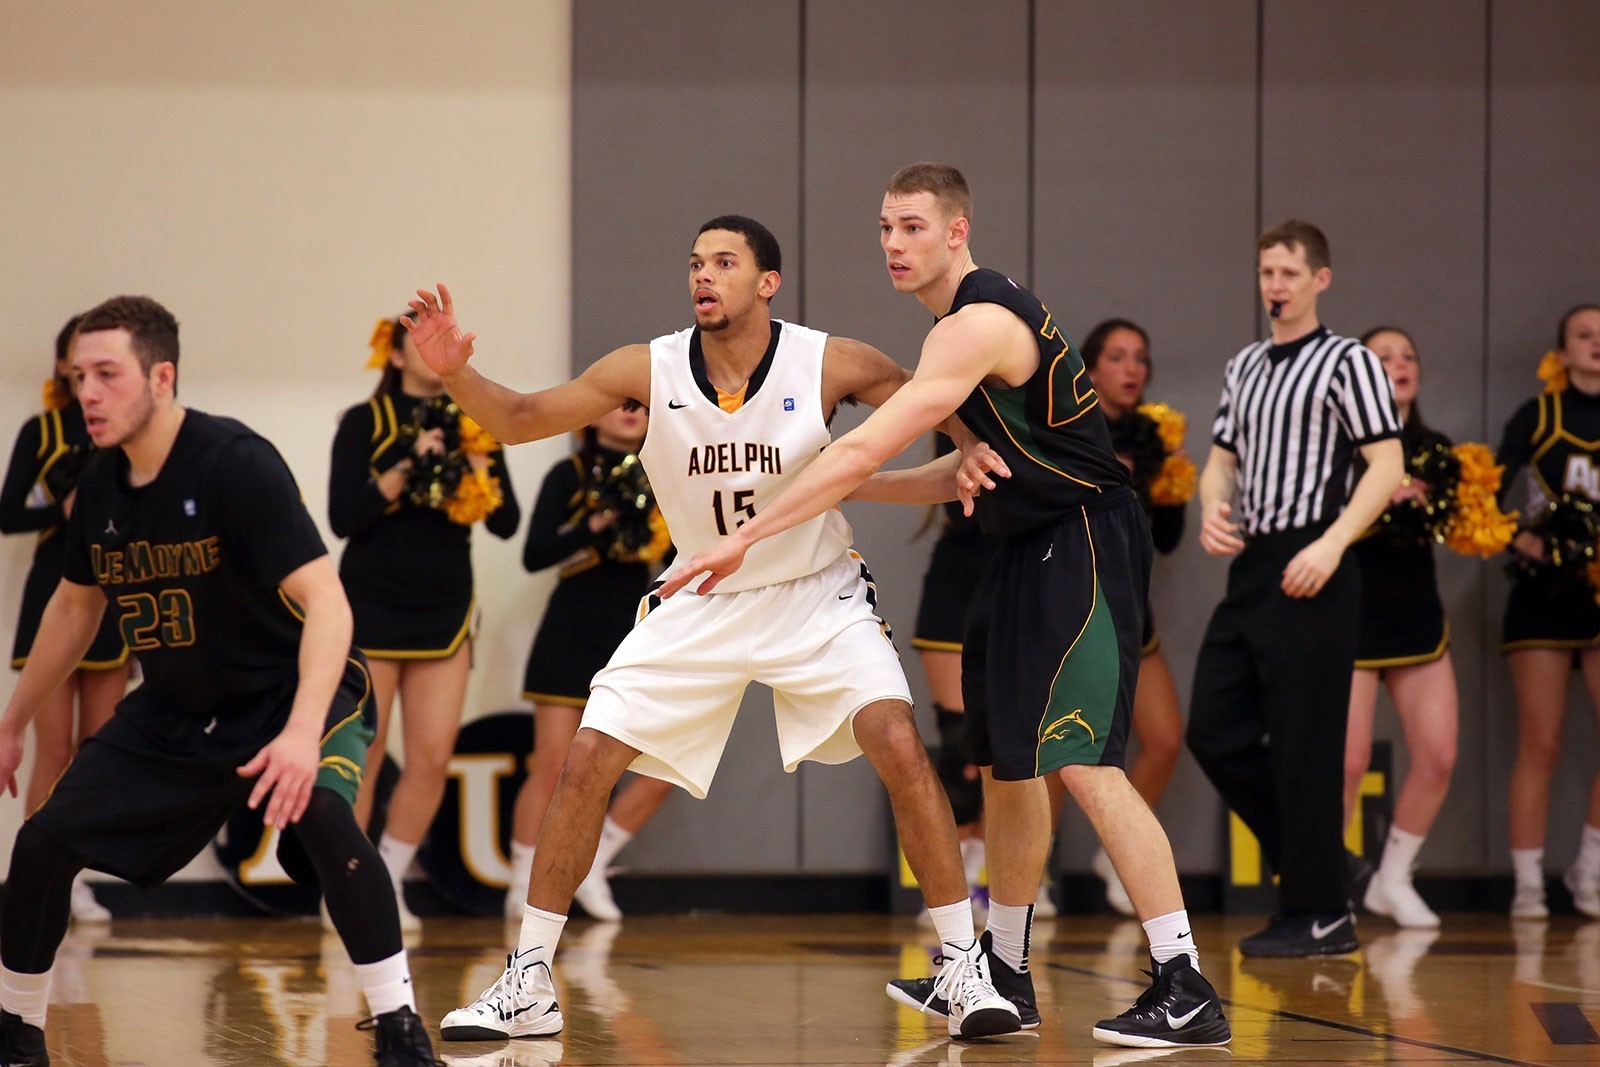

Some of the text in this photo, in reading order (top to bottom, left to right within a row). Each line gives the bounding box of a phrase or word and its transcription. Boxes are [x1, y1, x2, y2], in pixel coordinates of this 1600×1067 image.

[687, 442, 783, 477] ADELPHI
[712, 489, 757, 536] 15
[117, 588, 196, 651] 23
